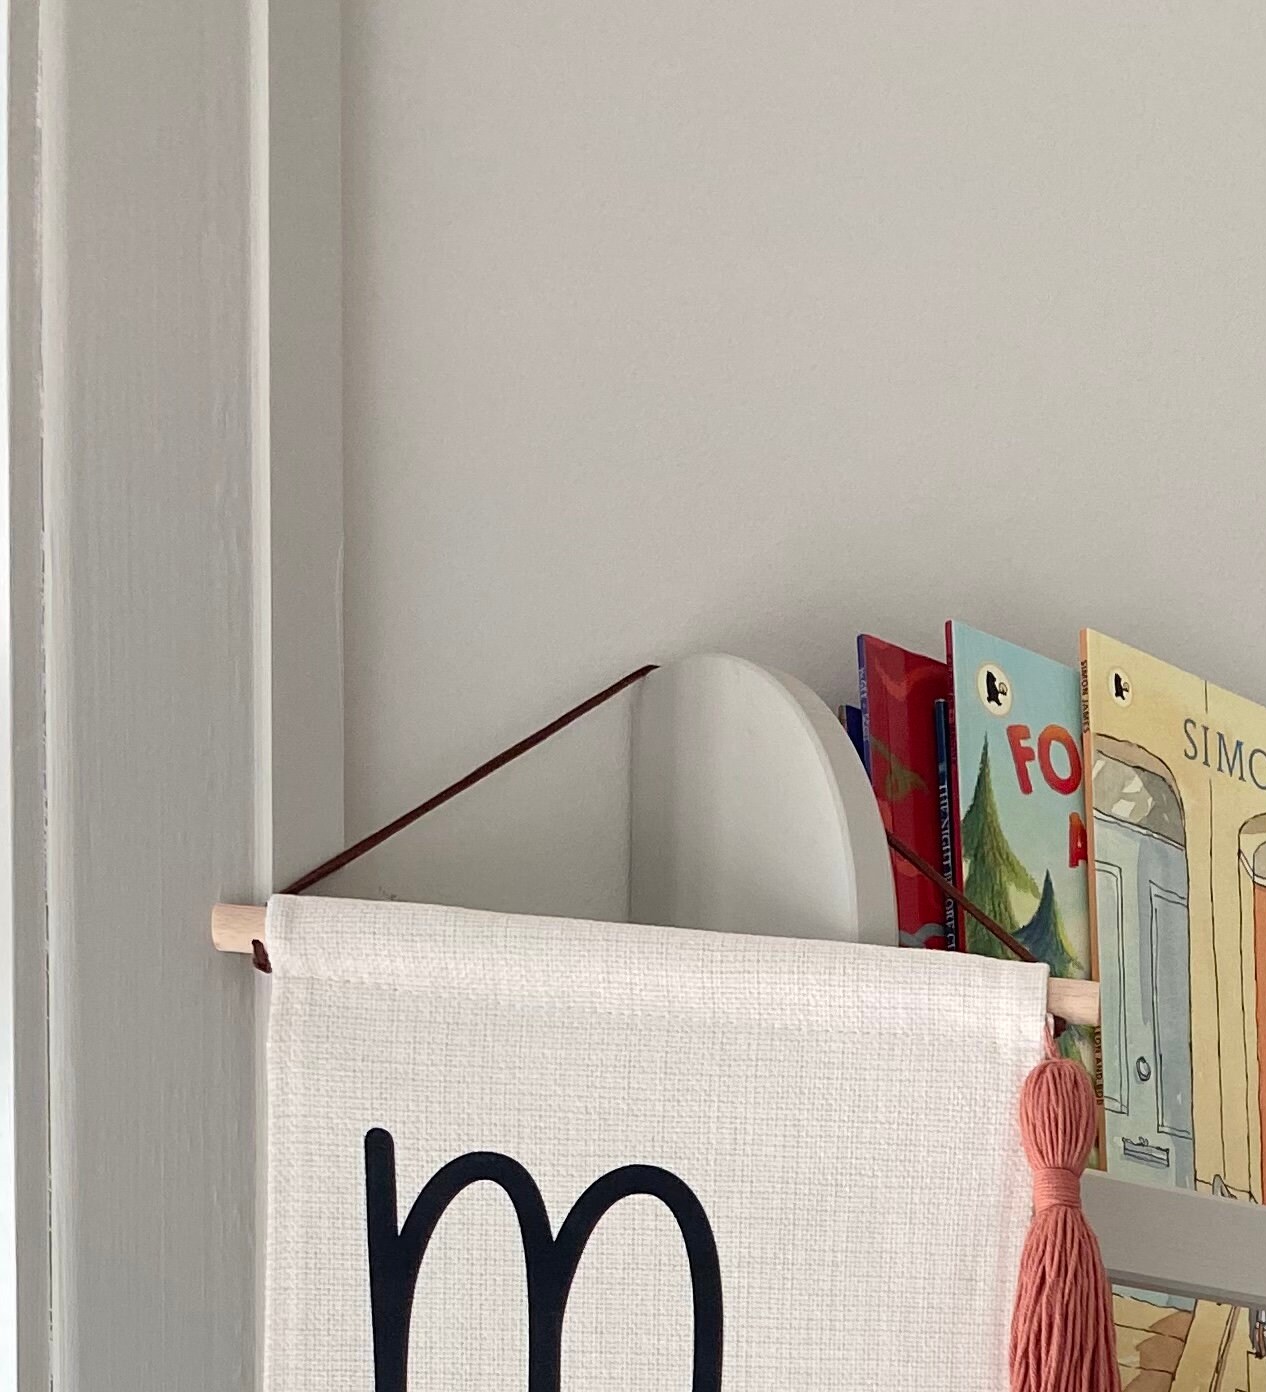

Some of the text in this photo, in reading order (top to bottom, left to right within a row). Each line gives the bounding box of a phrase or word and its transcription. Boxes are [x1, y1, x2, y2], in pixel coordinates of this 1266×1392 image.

[1081, 659, 1090, 733] SIMON JAMES
[1094, 1026, 1102, 1053] LEON
